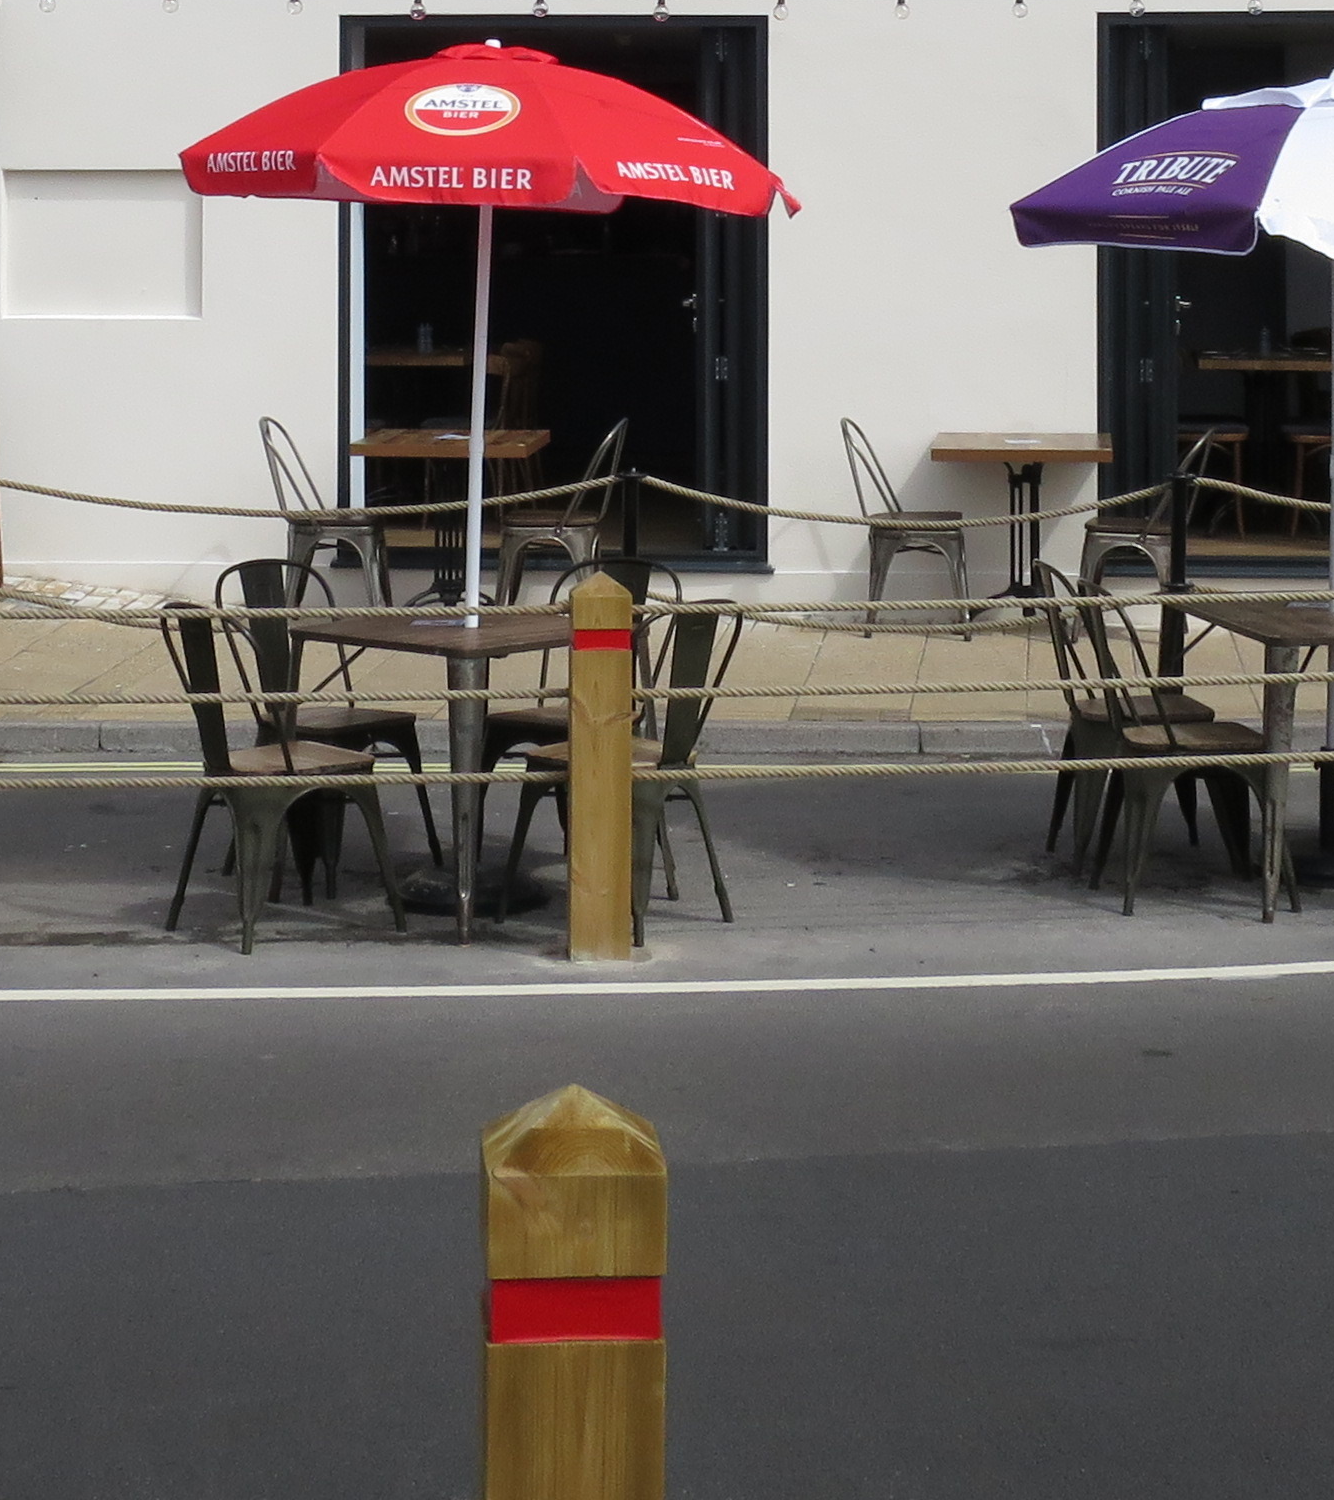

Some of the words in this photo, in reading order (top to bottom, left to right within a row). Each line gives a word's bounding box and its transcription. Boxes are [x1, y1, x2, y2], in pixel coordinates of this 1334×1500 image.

[423, 99, 504, 110] AMSTEL
[442, 110, 480, 119] BIER
[207, 151, 259, 172] AMSTEL
[261, 150, 297, 171] BIER
[1112, 155, 1238, 185] TRIBUTE
[370, 166, 464, 188] AMSTEL
[473, 167, 533, 190] BIER
[616, 161, 690, 182] AMSTEL
[688, 165, 735, 191] BIER
